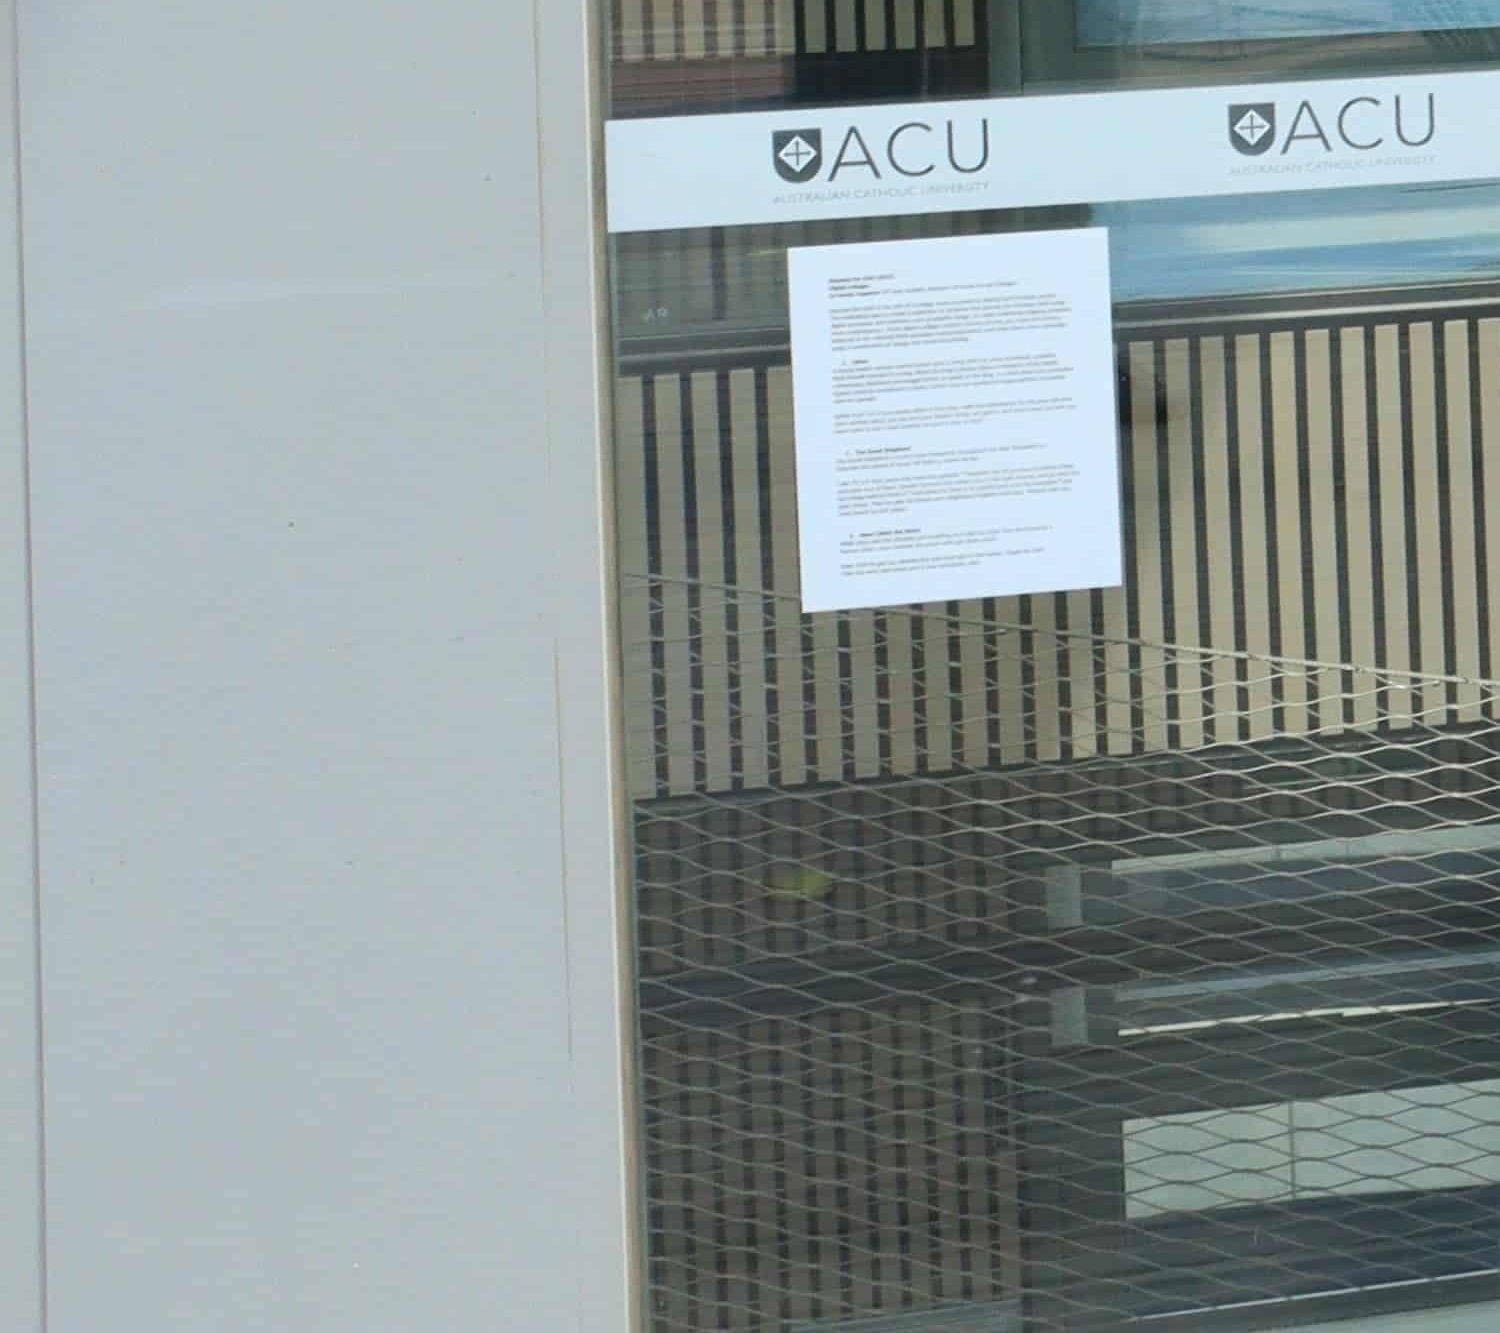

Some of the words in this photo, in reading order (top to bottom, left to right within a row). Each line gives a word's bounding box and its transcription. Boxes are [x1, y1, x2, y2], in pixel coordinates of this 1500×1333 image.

[828, 118, 989, 181] ACU
[1280, 93, 1434, 155] ACU
[854, 184, 915, 200] CATHOLIC
[920, 181, 989, 196] UNIVERSITY
